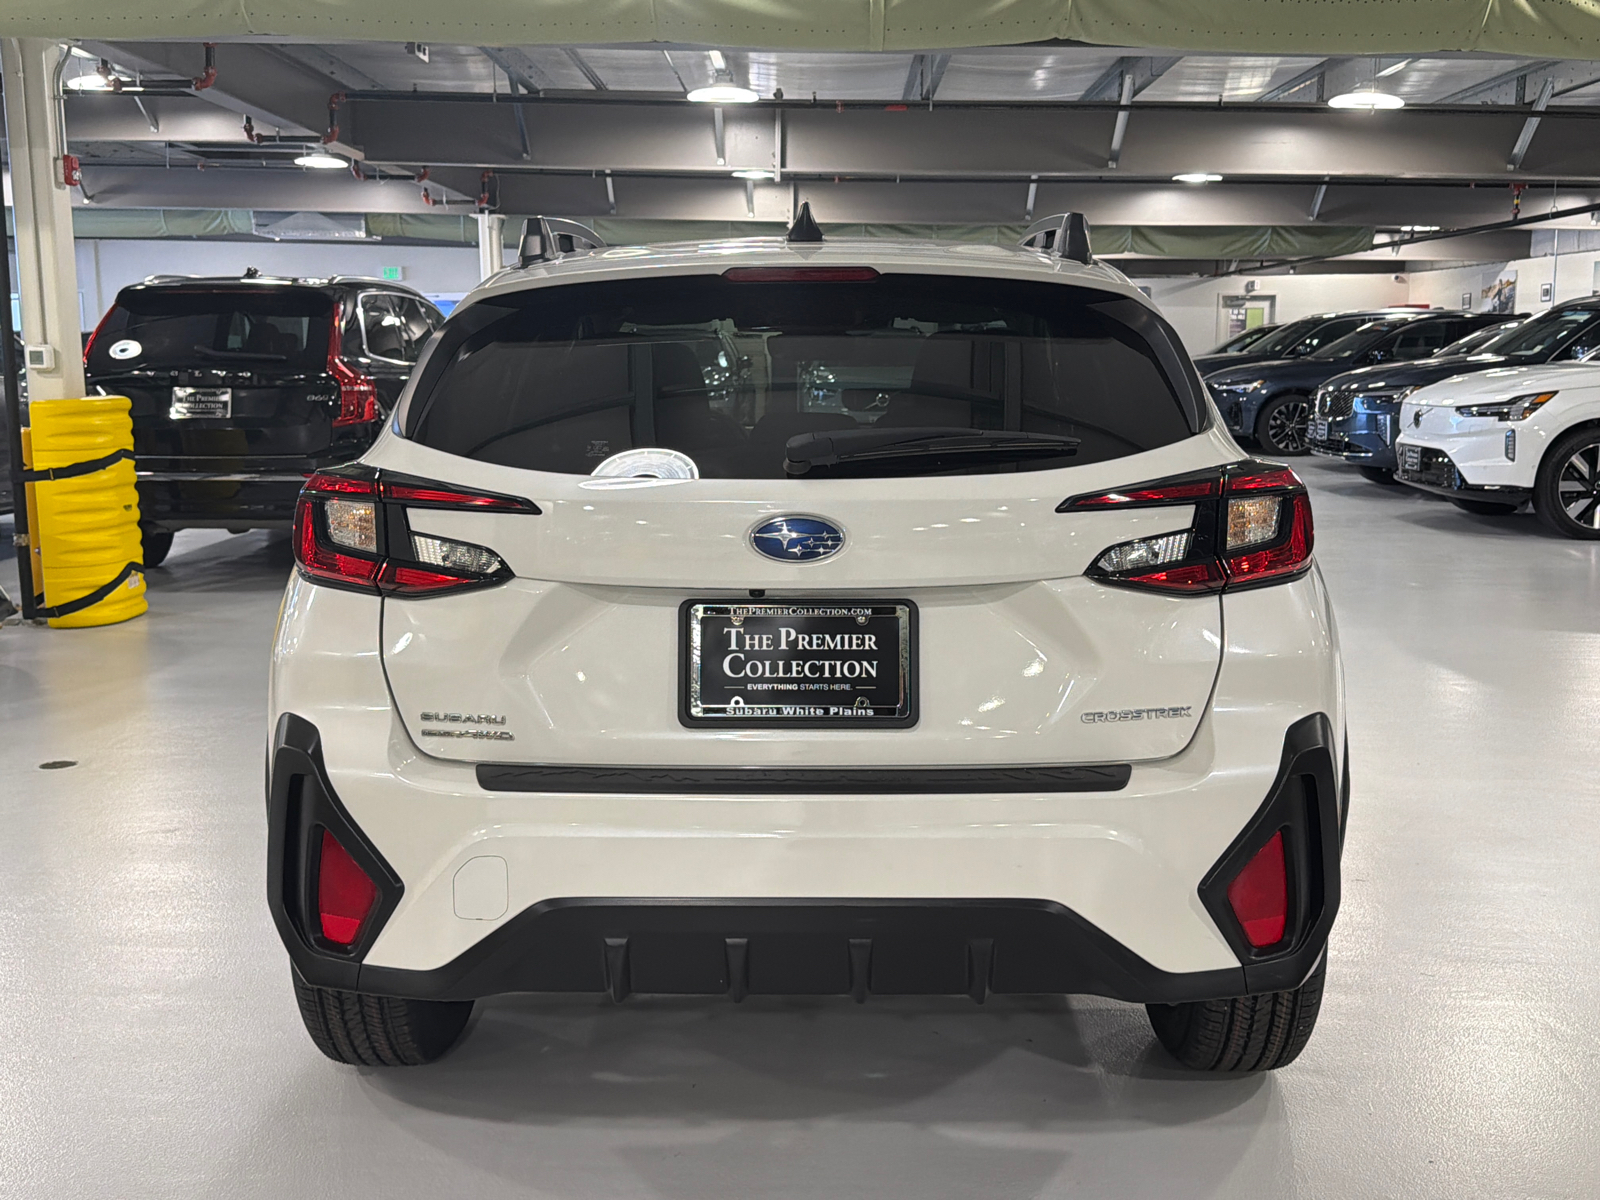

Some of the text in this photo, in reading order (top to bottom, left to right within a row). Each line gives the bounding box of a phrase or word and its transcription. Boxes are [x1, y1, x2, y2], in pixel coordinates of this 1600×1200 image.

[722, 653, 878, 678] COLLECTION
[747, 683, 799, 691] EVERYTHING
[799, 683, 829, 691] STARTS
[420, 712, 506, 725] SUBARU
[725, 707, 874, 717] Subaru White Plains
[1080, 706, 1192, 724] CROSSTREK
